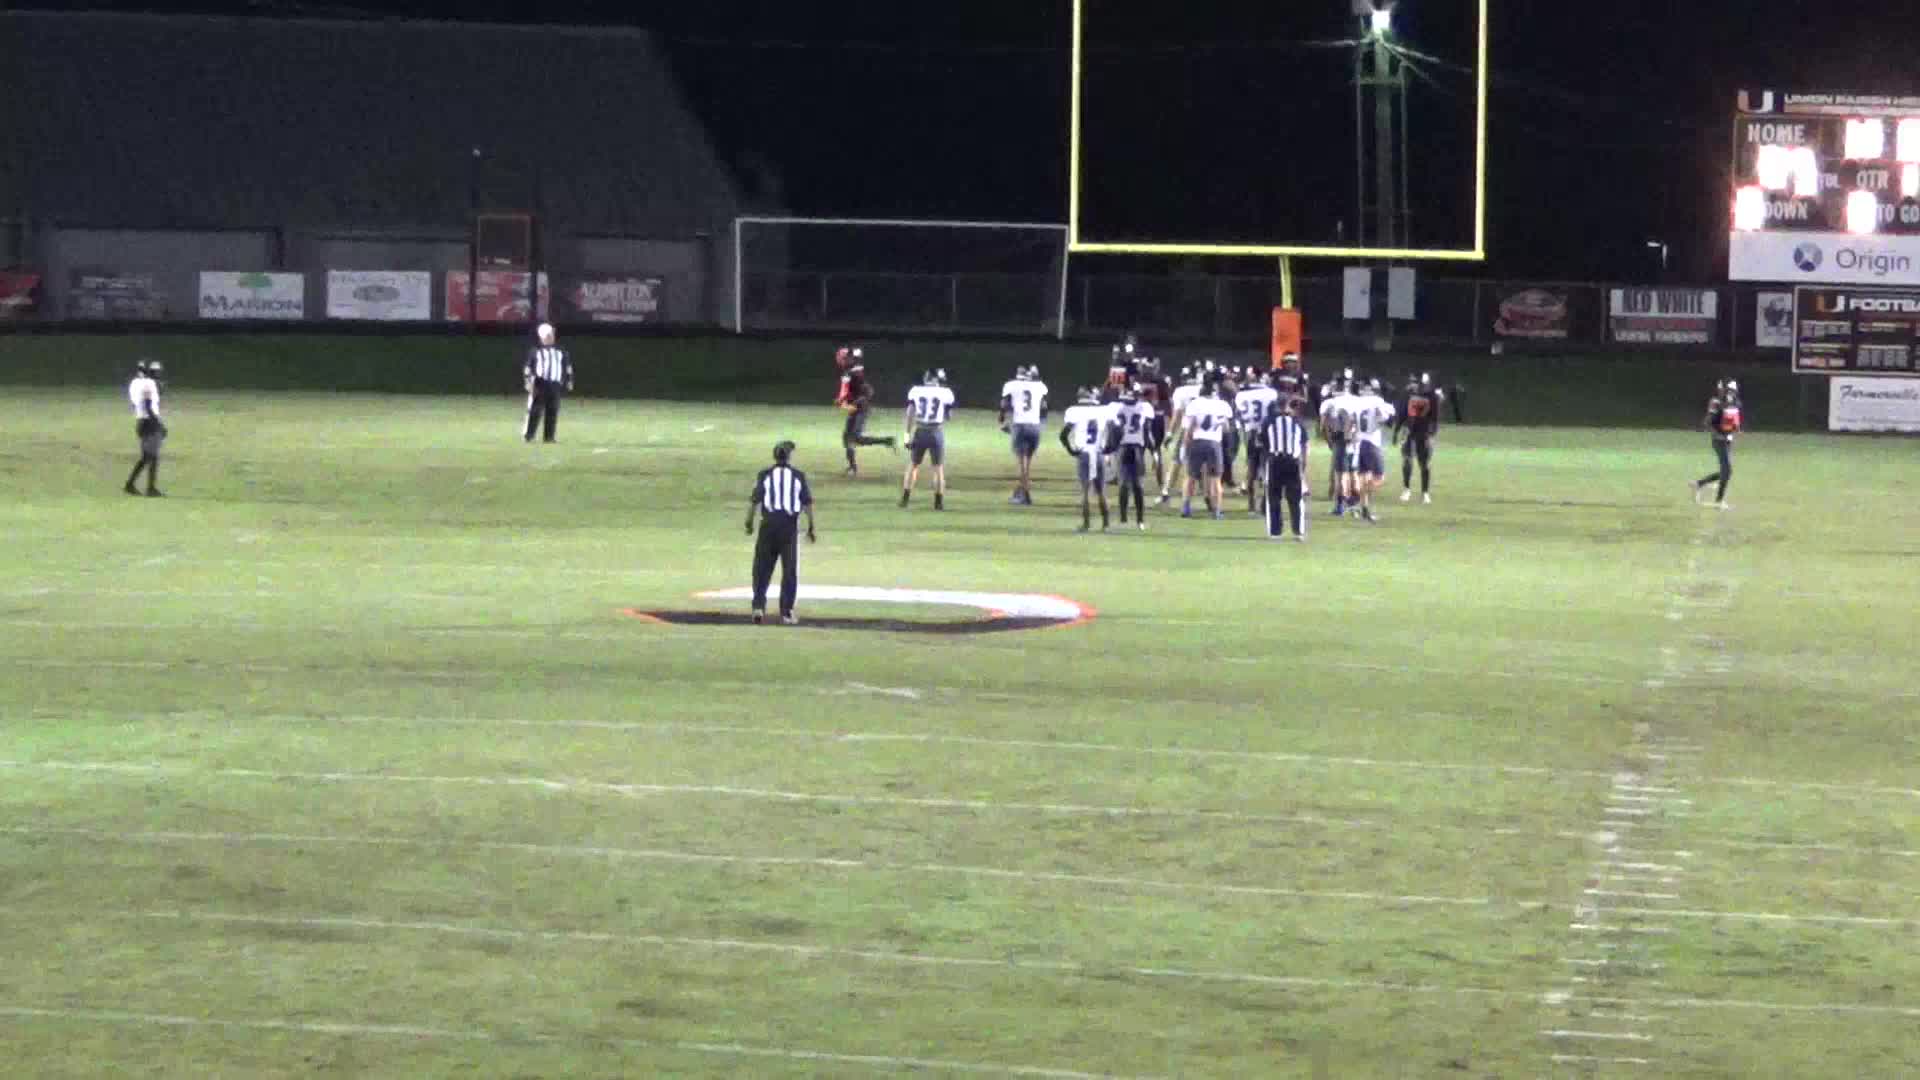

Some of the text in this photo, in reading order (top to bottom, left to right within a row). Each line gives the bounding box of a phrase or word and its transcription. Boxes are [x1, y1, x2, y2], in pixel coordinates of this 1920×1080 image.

[1748, 123, 1805, 144] HOME
[1765, 201, 1808, 220] DOWN
[1836, 248, 1911, 276] Origin
[917, 396, 941, 420] 33
[1022, 390, 1033, 412] 3
